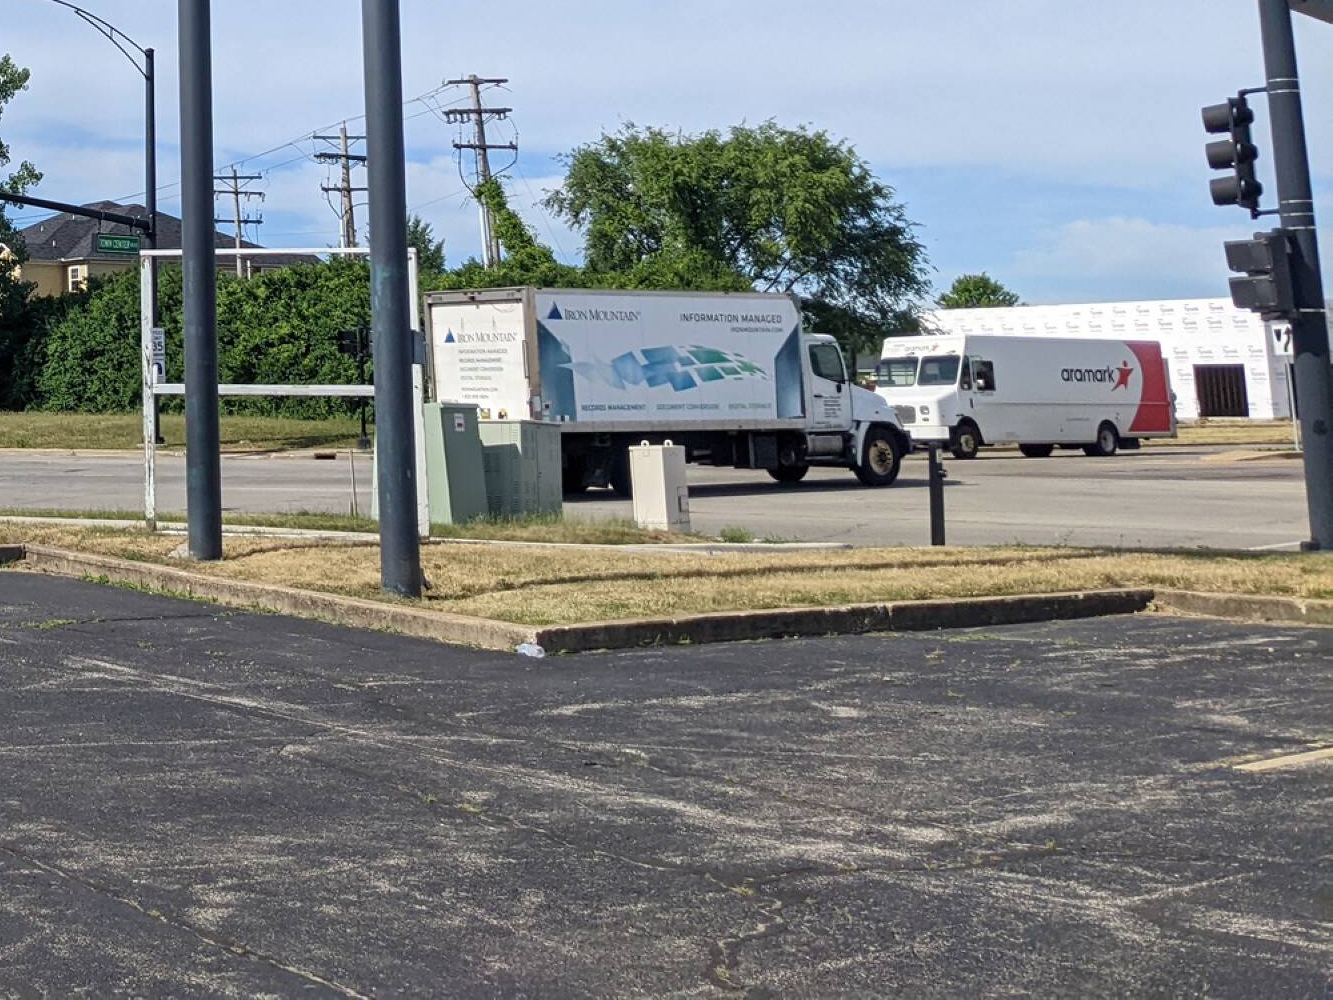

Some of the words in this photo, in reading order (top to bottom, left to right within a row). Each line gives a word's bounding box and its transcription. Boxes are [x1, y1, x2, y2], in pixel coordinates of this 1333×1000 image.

[564, 308, 587, 321] IRON
[679, 312, 739, 323] INFORMATION
[741, 313, 783, 324] MANAGED
[457, 332, 474, 343] IRON
[1060, 365, 1115, 383] aramark
